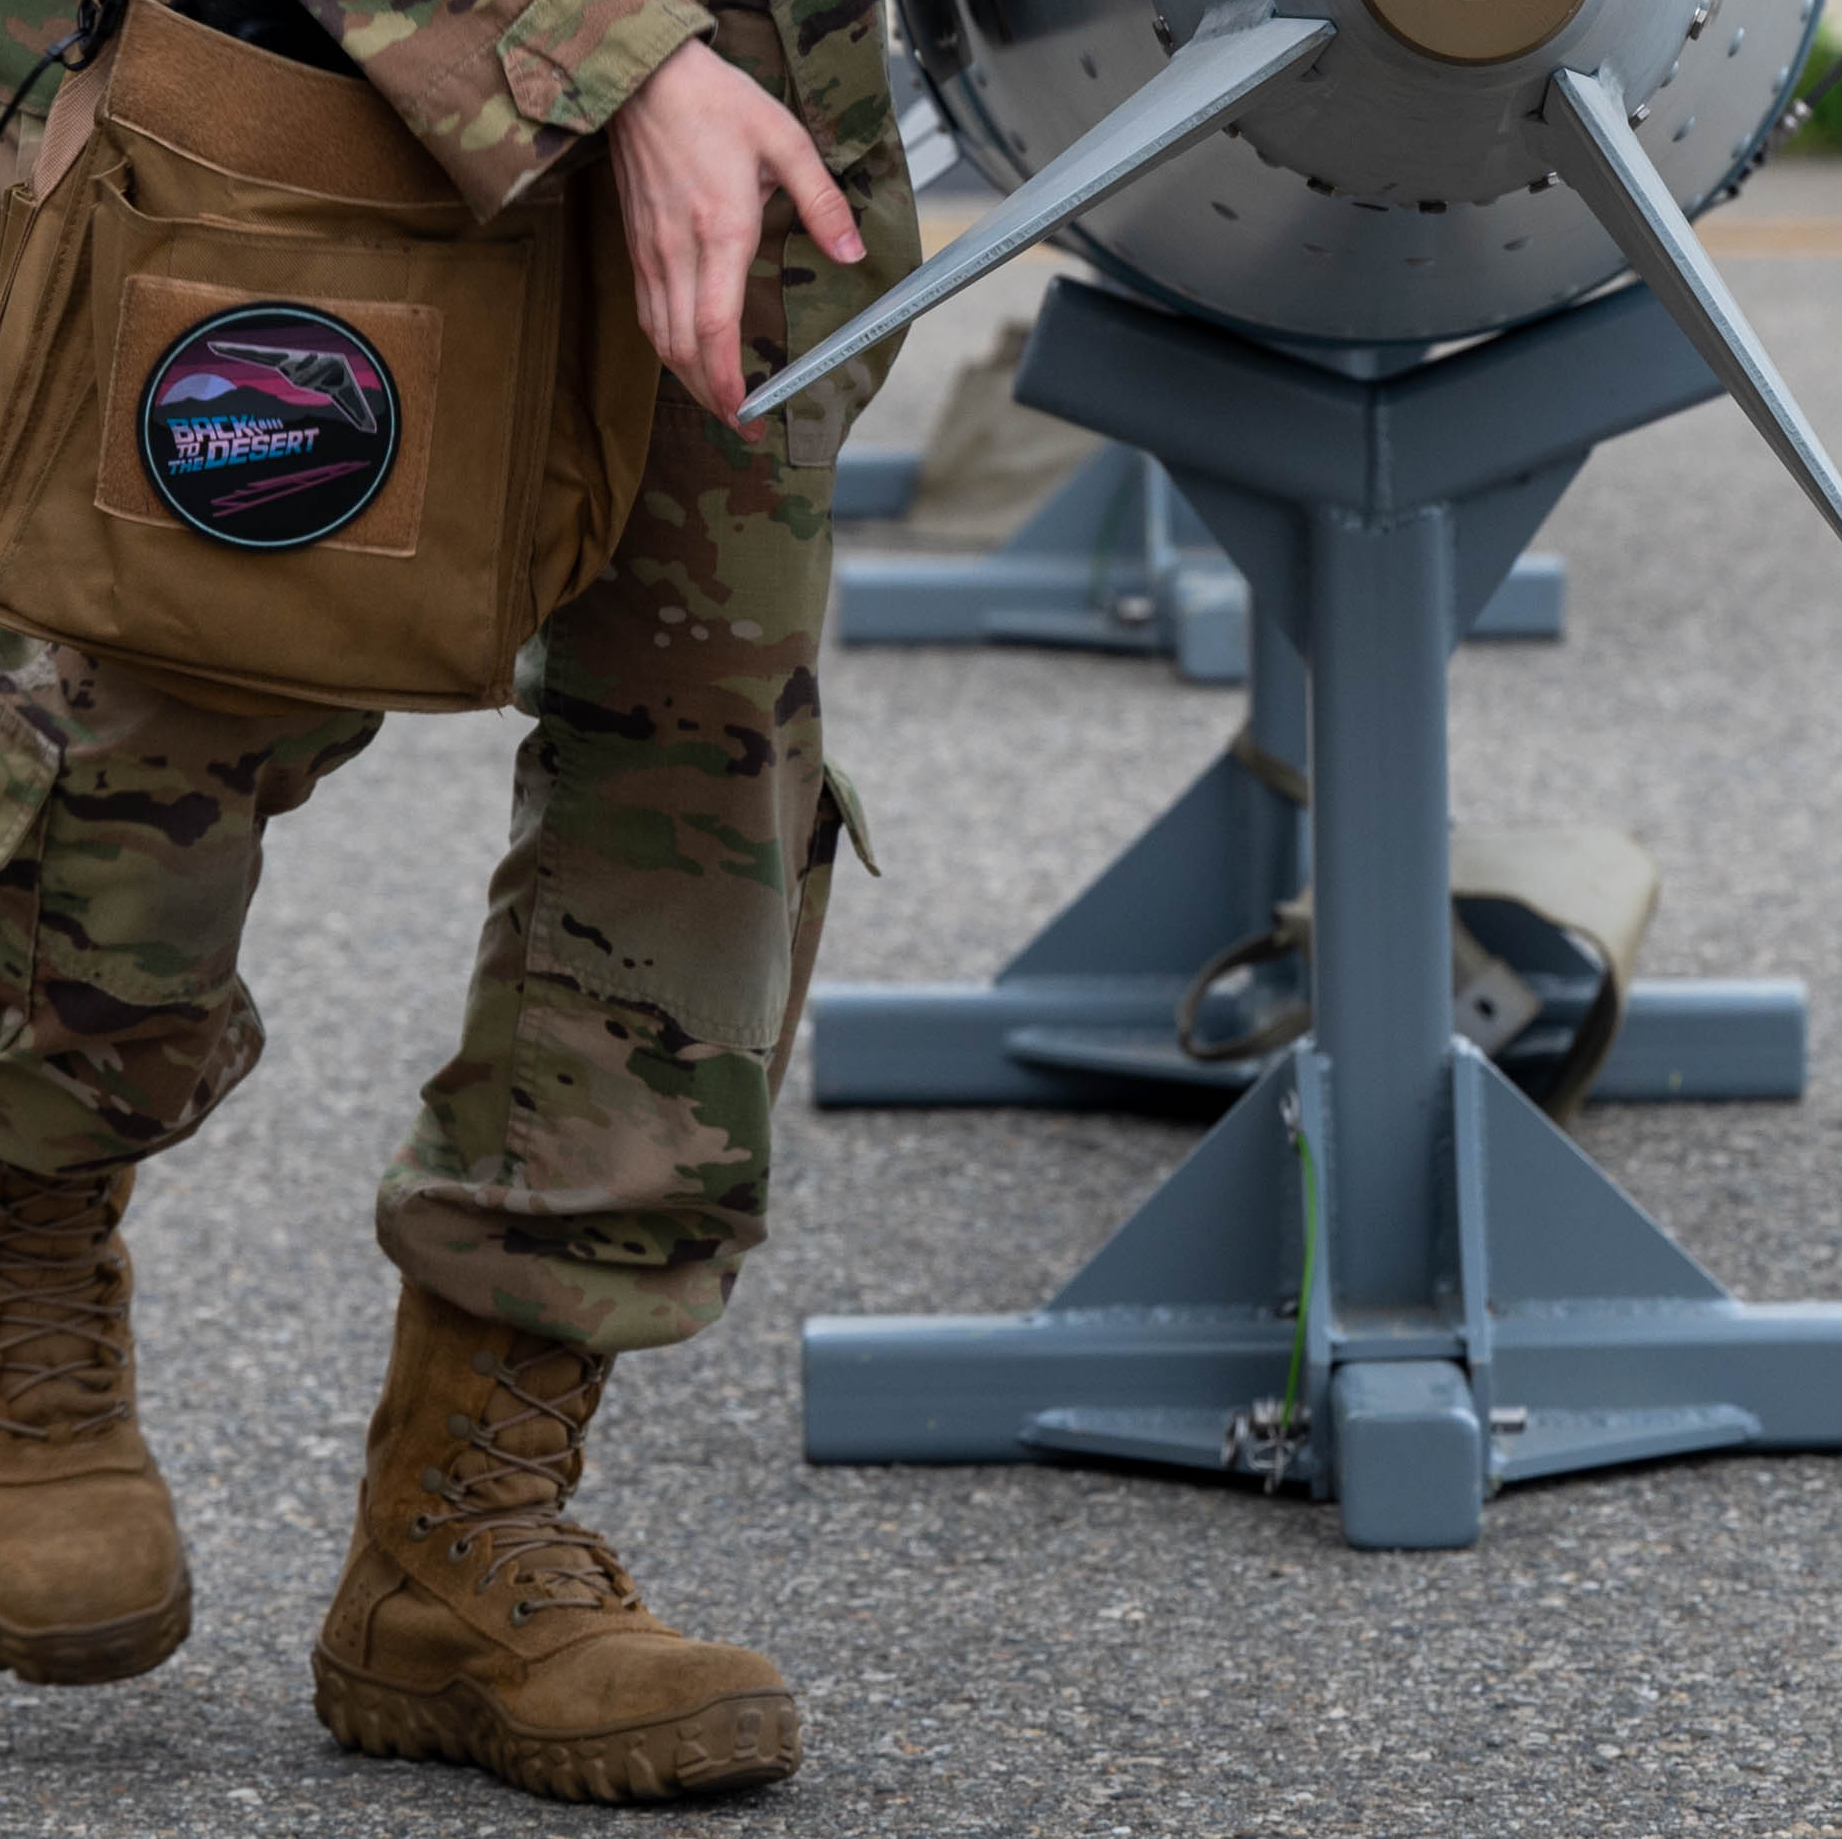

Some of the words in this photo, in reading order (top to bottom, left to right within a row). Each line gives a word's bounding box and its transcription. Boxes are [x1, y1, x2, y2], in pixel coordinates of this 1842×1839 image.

[167, 415, 255, 443] BACK
[176, 443, 200, 458] TO
[205, 428, 319, 469] DESERT
[168, 456, 204, 476] THE
